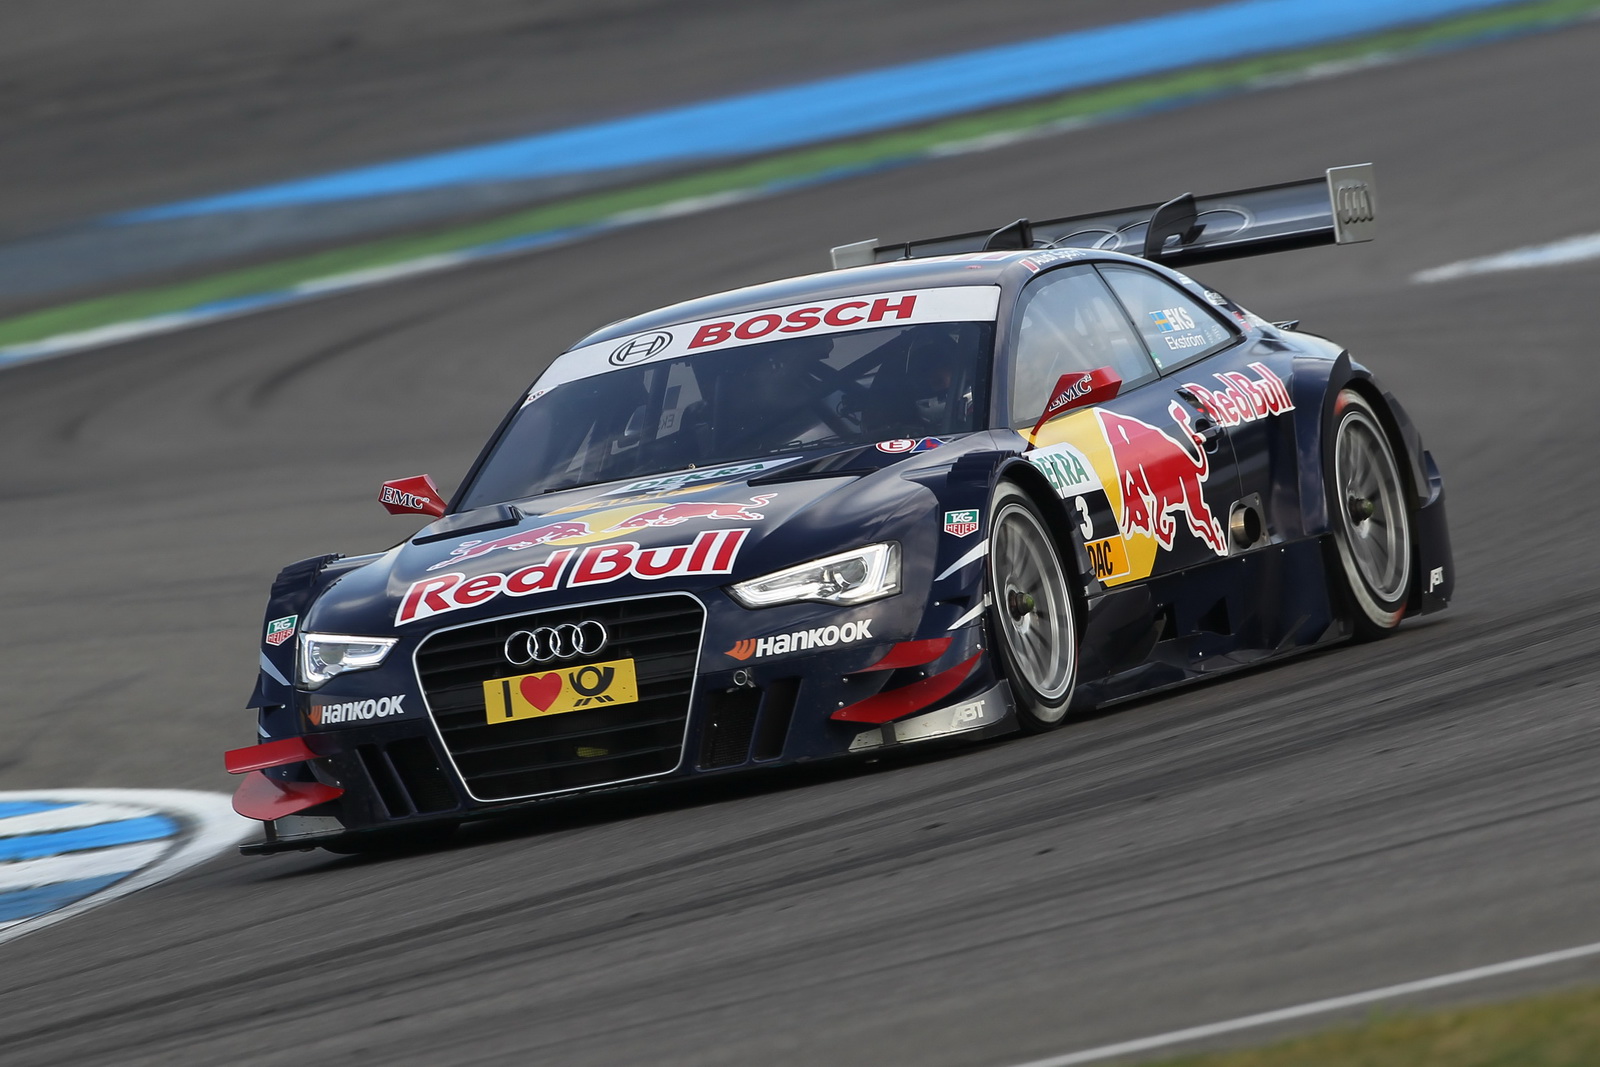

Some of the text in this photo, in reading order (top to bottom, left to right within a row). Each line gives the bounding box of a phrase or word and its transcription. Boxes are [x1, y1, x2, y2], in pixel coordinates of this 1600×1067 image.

[687, 295, 917, 350] BOSCH
[1163, 307, 1195, 331] EKS
[1165, 334, 1206, 350] Ekström
[1180, 361, 1295, 428] Red Bull
[627, 463, 765, 491] DEKRA
[947, 523, 976, 535] HEUER
[951, 511, 973, 523] TAG
[1075, 496, 1094, 540] 3
[396, 530, 749, 625] Red Bull
[268, 628, 293, 646] HEUER
[272, 618, 292, 632] TAG
[502, 680, 513, 717] I
[951, 700, 985, 728] ABT
